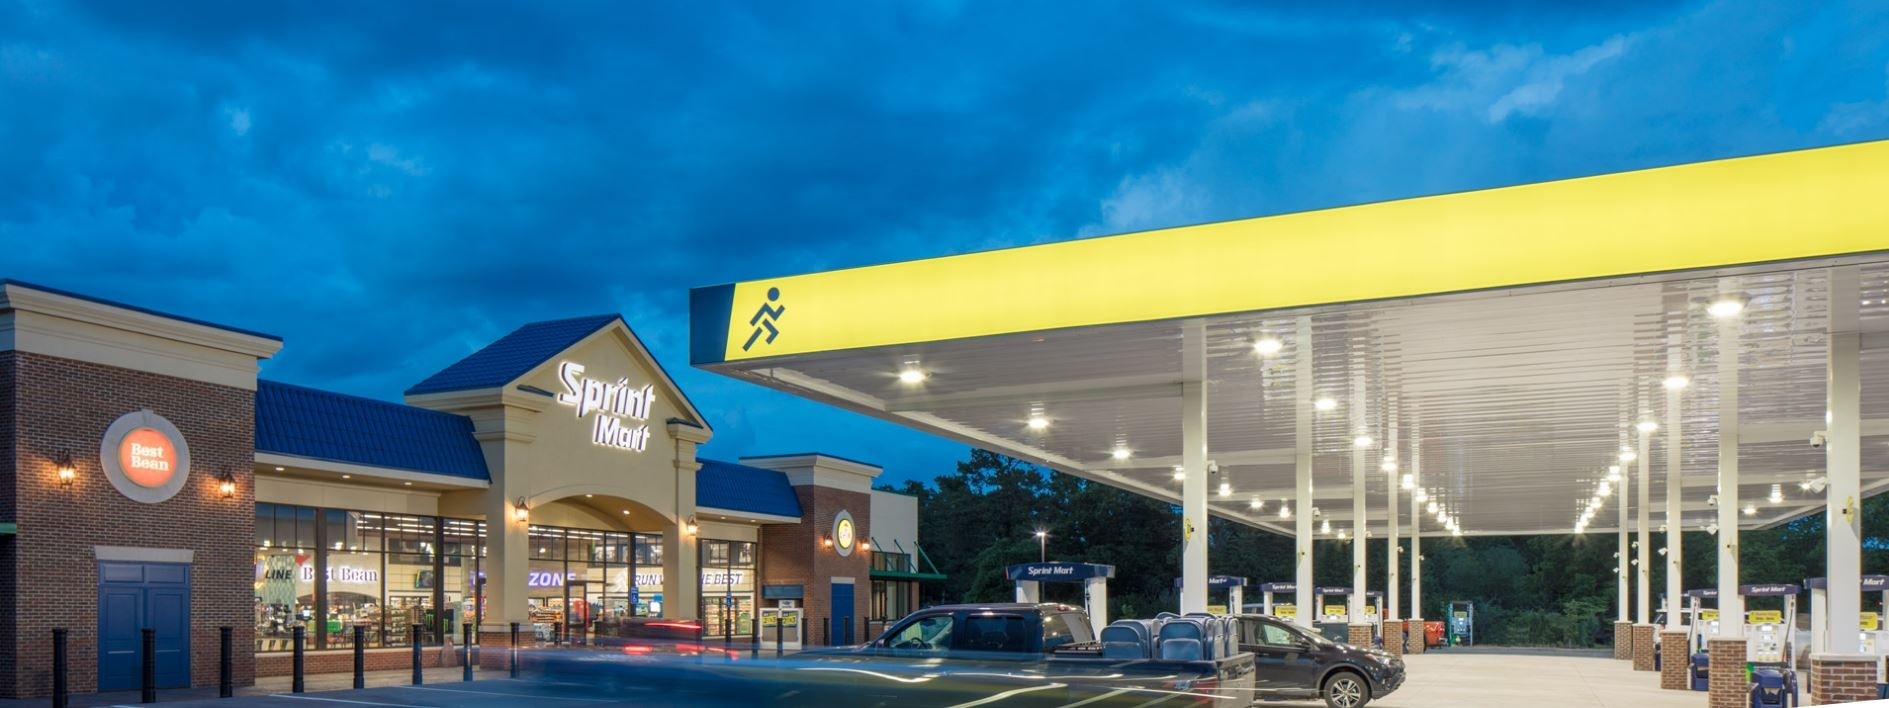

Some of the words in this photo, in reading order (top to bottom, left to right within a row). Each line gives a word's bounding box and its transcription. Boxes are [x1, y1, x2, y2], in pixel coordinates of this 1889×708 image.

[558, 361, 655, 420] Sprint
[593, 414, 650, 452] Mart
[131, 442, 164, 458] Best
[131, 455, 169, 471] Bean
[265, 569, 292, 580] LINE
[341, 567, 377, 581] Bean
[1028, 566, 1052, 576] Sprint
[1053, 566, 1073, 575] Mart
[635, 574, 657, 585] RUN
[713, 573, 743, 585] BEST
